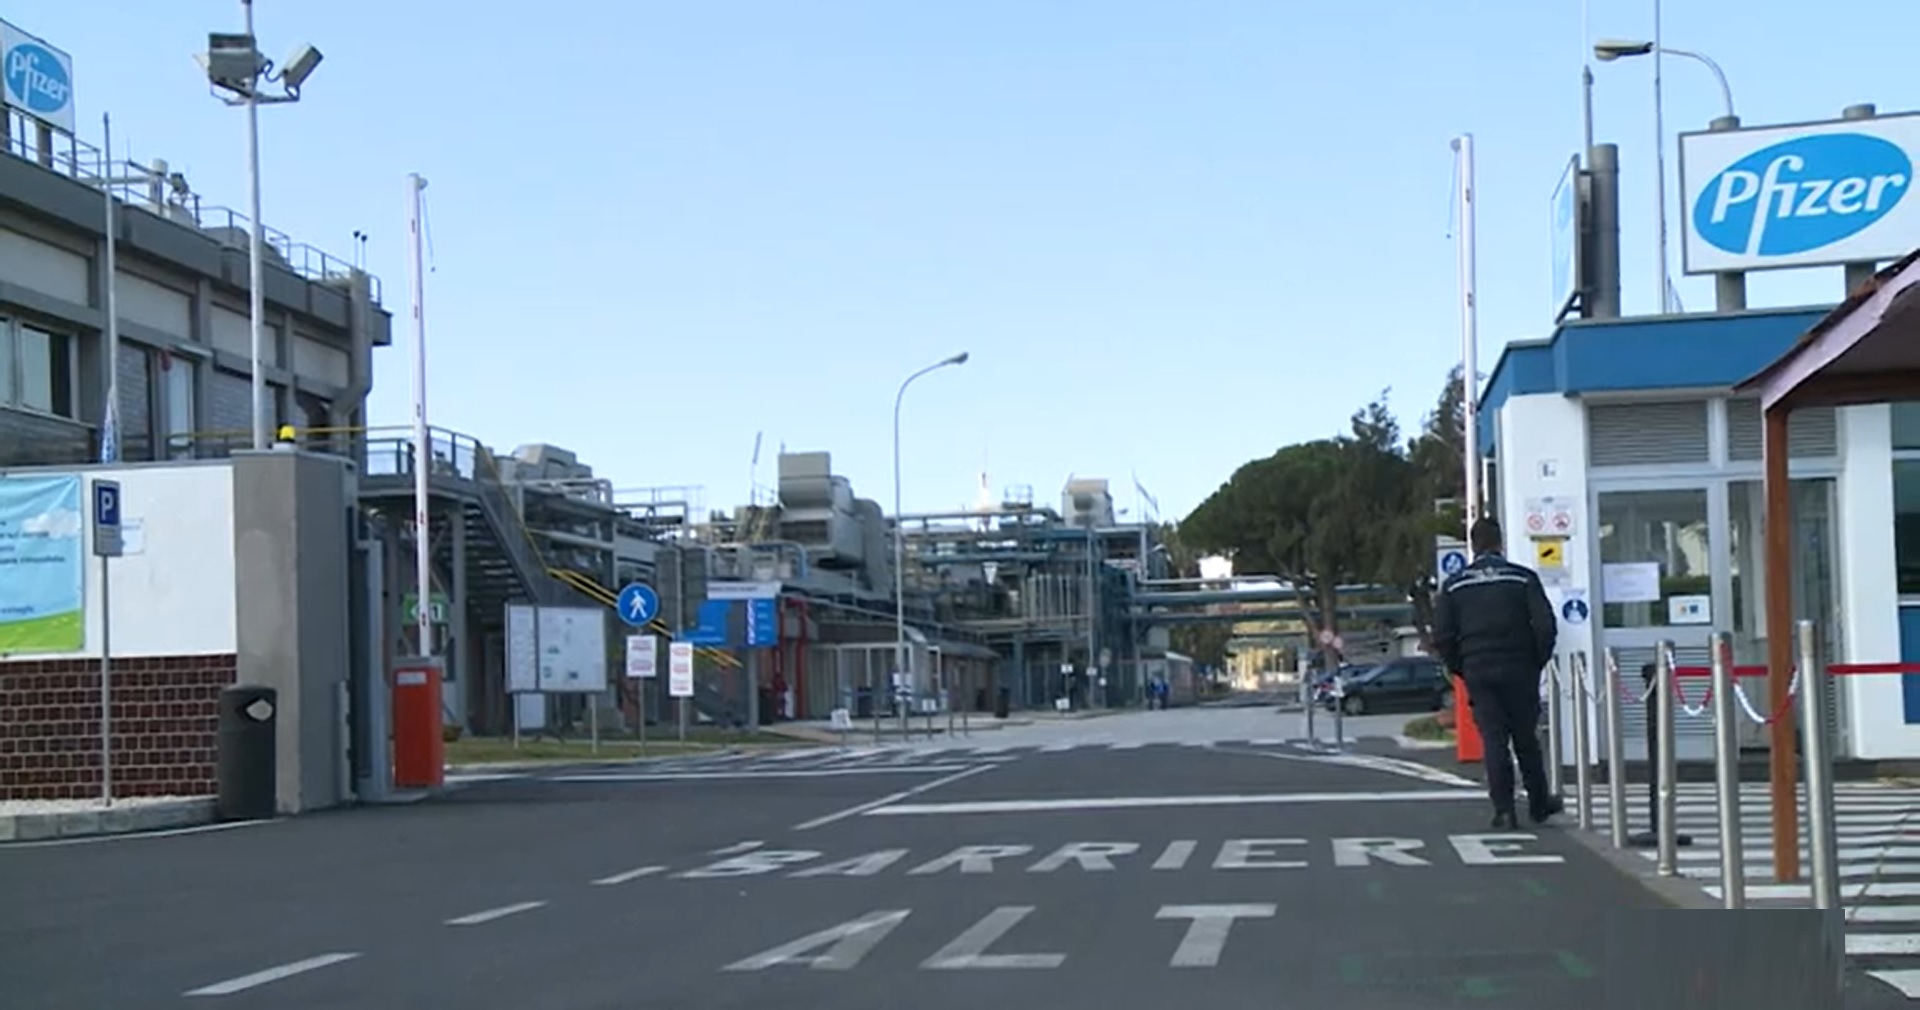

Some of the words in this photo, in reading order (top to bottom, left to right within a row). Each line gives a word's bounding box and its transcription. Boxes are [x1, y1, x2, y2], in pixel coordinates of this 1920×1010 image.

[10, 51, 68, 104] Pfizer
[1711, 155, 1905, 256] Pfizer
[100, 491, 114, 521] P
[667, 833, 1566, 878] BARRIERE
[717, 903, 1276, 970] ALT
